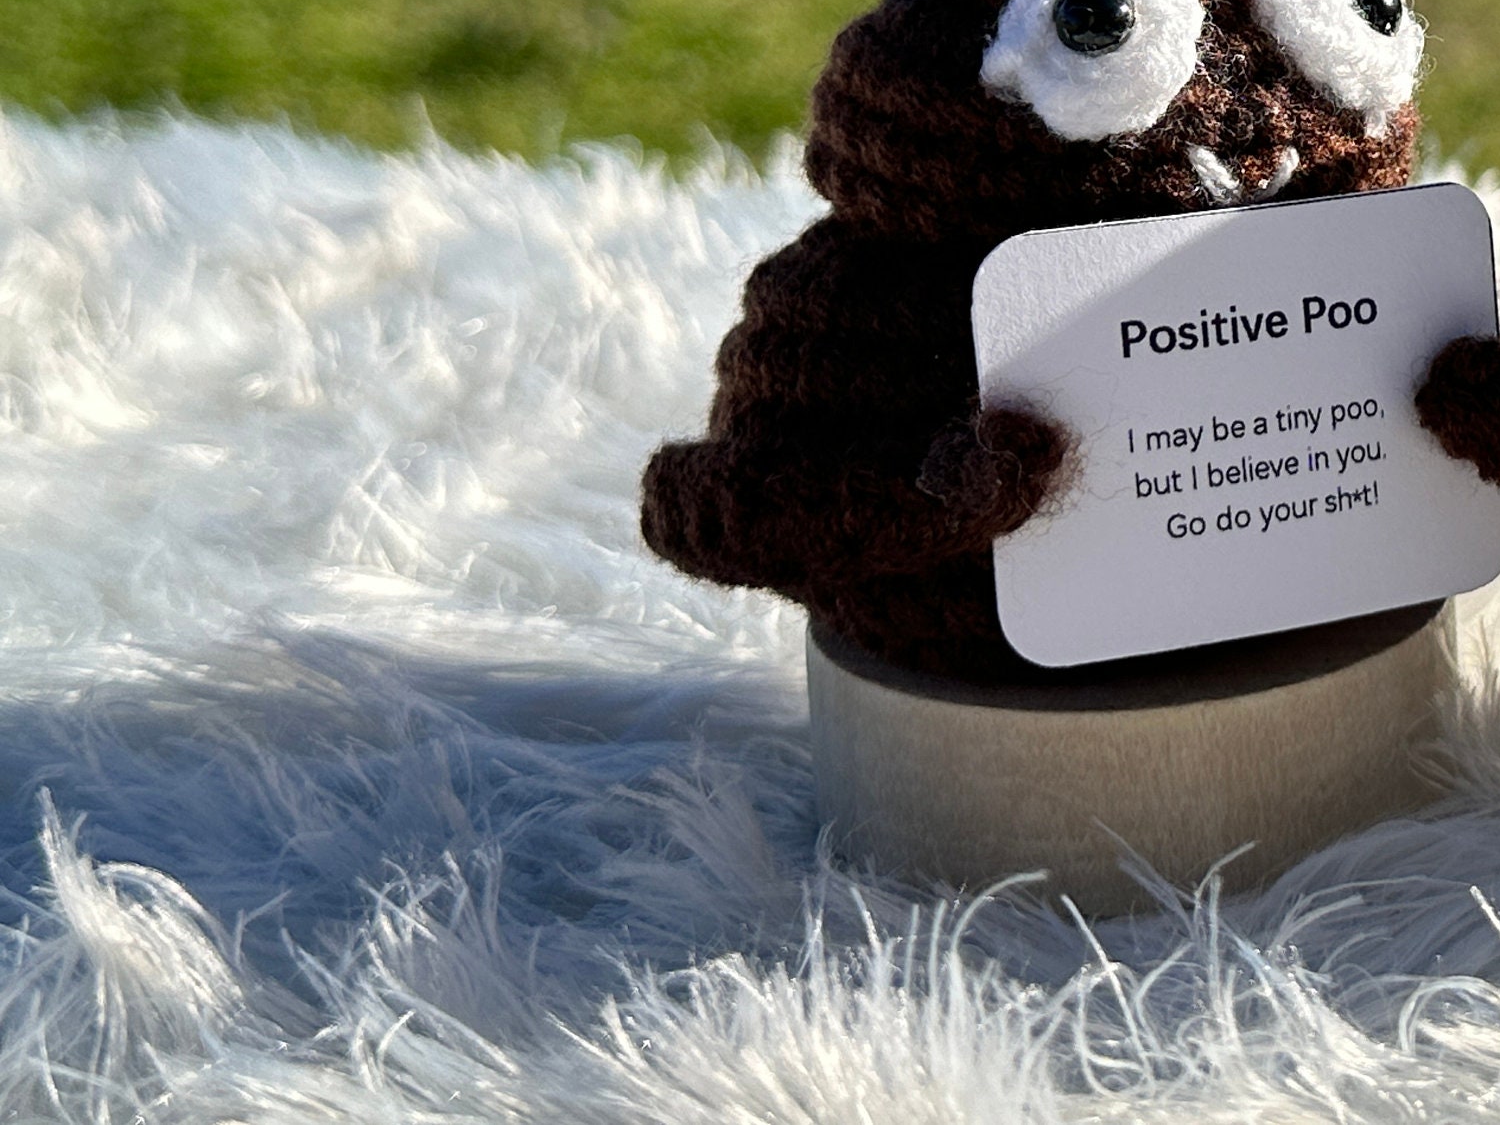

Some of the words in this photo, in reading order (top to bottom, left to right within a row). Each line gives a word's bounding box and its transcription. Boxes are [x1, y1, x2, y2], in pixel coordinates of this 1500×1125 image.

[1120, 305, 1289, 358] Positive
[1301, 295, 1378, 334] Poo
[1128, 428, 1135, 453] I
[1145, 426, 1204, 453] may
[1212, 415, 1246, 442] be
[1253, 416, 1268, 436] a
[1275, 404, 1323, 434] tiny
[1330, 398, 1385, 431] poo,
[1134, 470, 1183, 498] but
[1191, 466, 1198, 490] I
[1207, 455, 1300, 488] believe
[1306, 446, 1330, 472] in
[1166, 513, 1206, 539] Go
[1215, 504, 1251, 532] do
[1258, 496, 1319, 533] your
